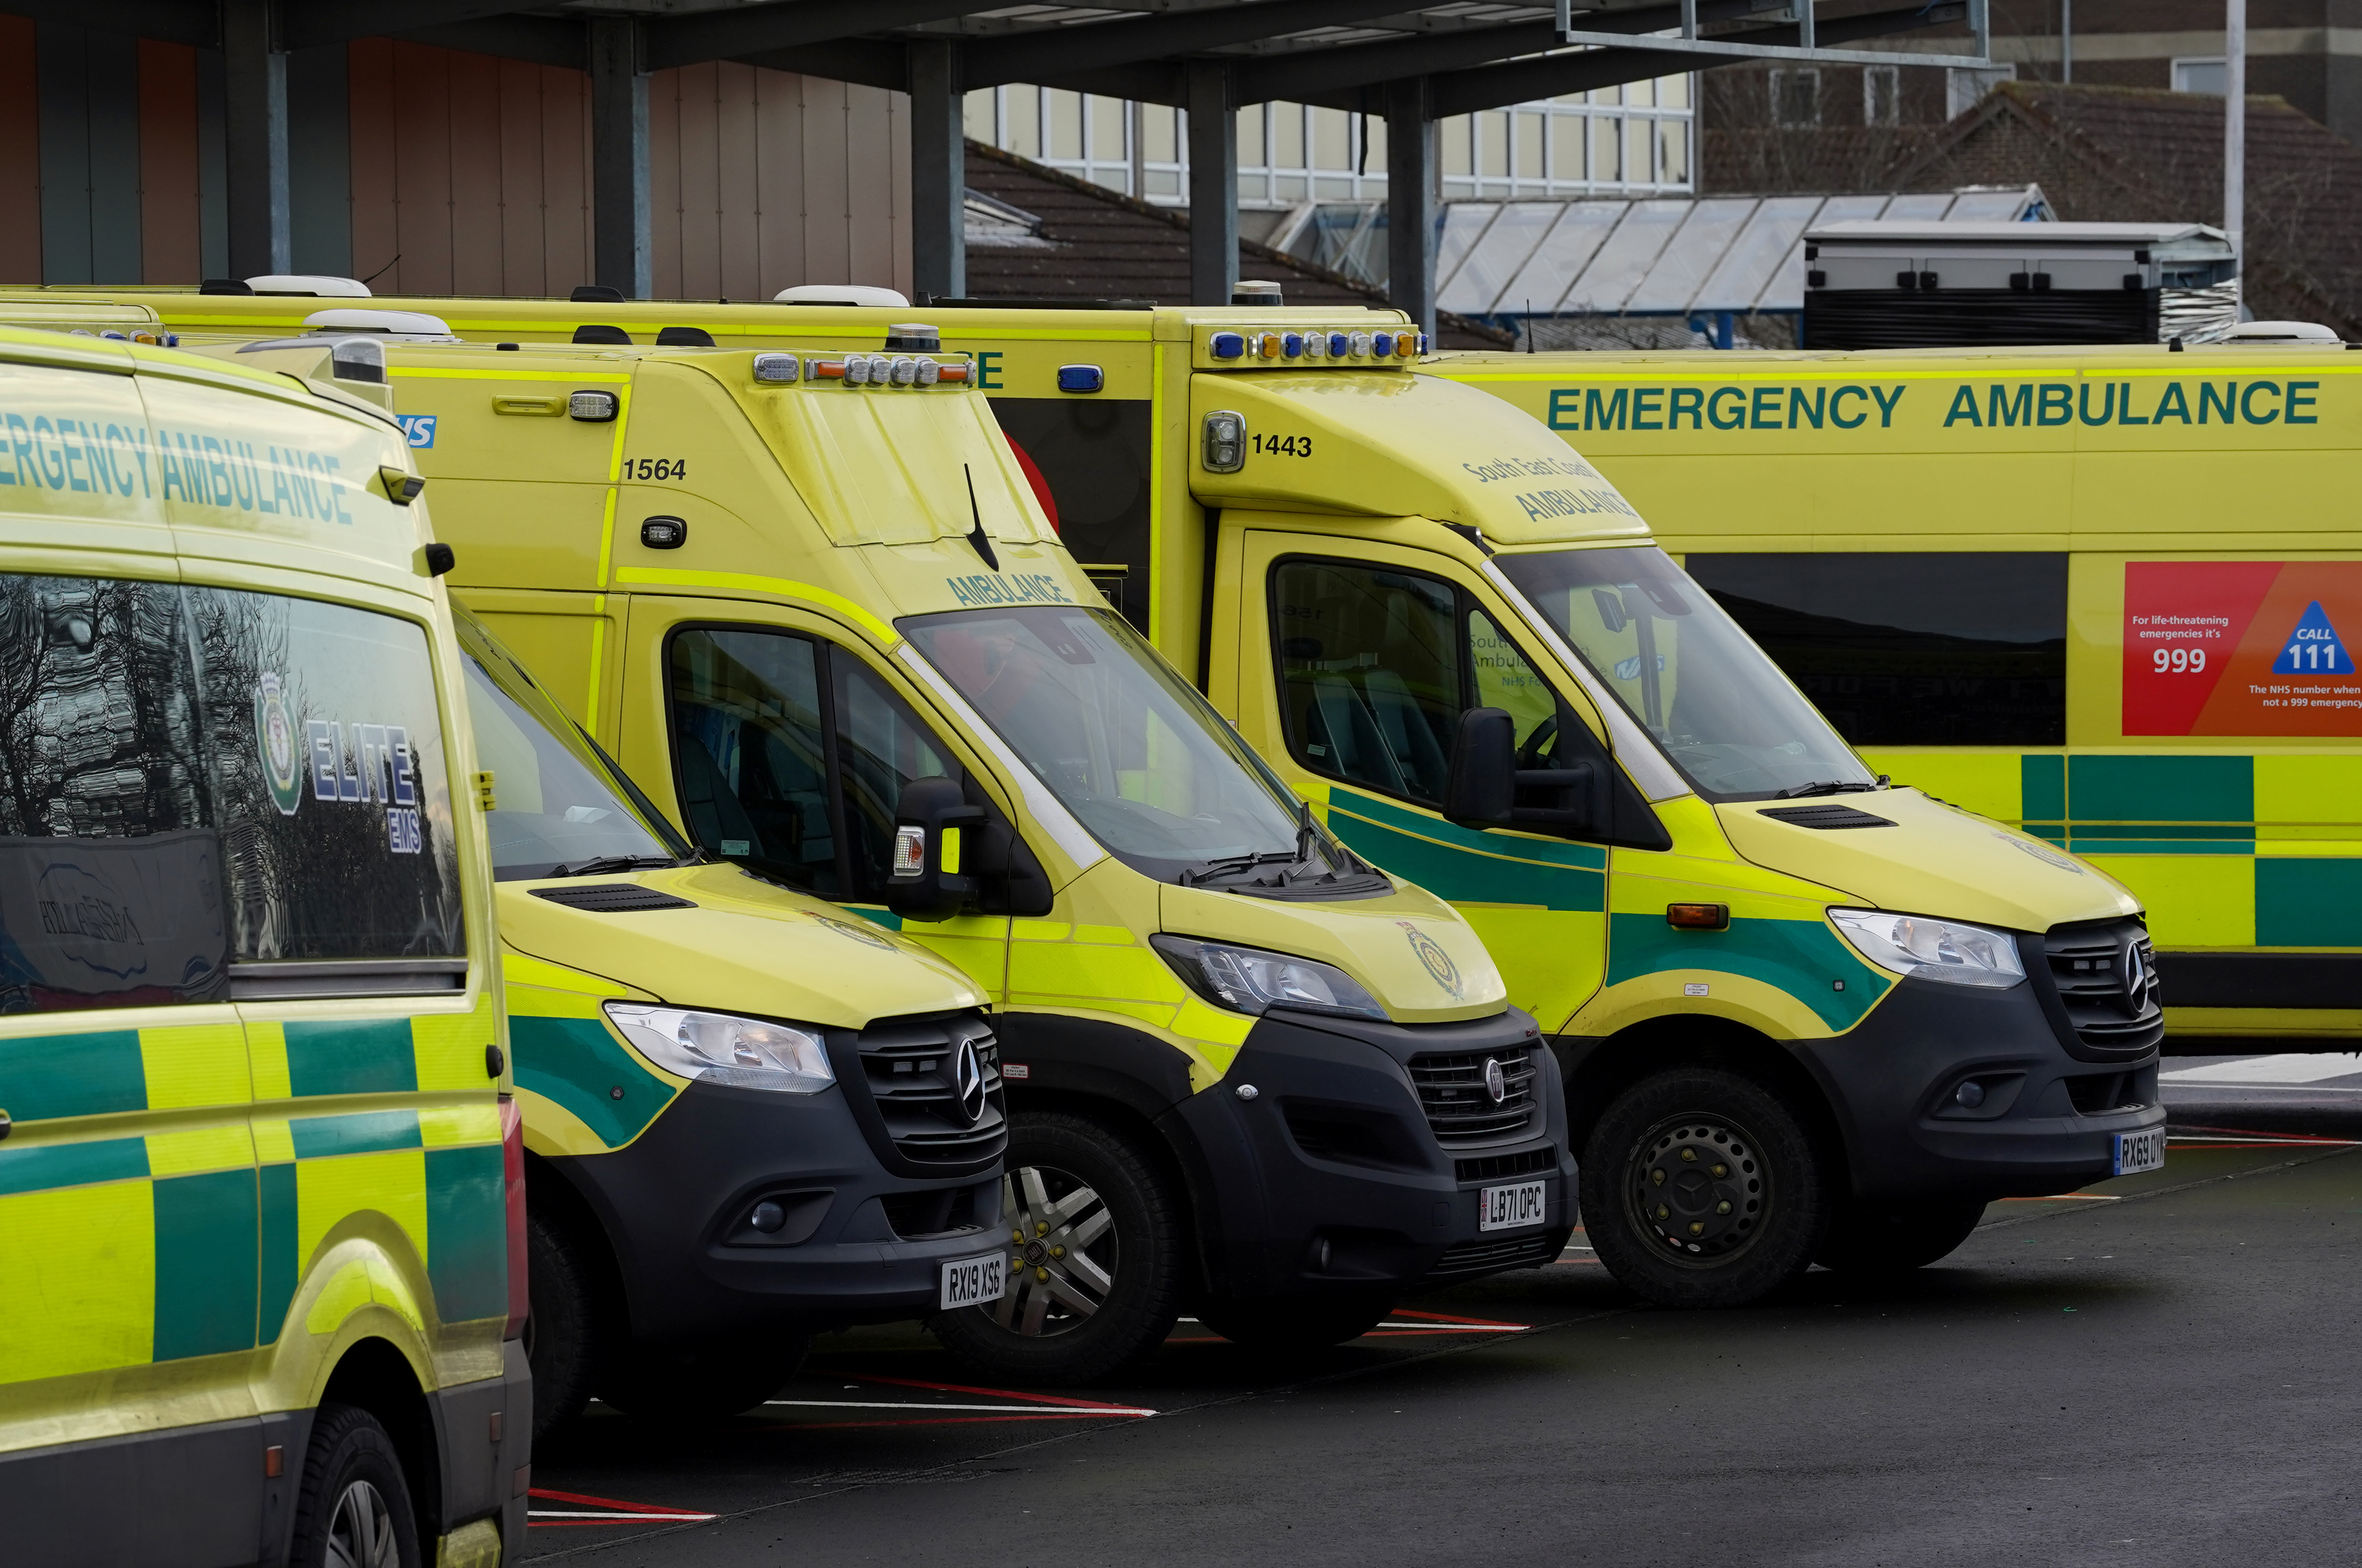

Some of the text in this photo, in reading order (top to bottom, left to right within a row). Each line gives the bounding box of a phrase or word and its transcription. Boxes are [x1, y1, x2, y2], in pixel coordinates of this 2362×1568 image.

[1549, 381, 2319, 431] EMERGENCY AMBULANCE
[1252, 434, 1311, 458] 1443
[160, 430, 353, 525] AMBULANCE
[624, 459, 686, 480] 1564
[1463, 458, 1599, 482] South East Coast
[1515, 490, 1639, 522] AMBULANCE
[946, 574, 1073, 606] AMBULANCE
[2133, 615, 2229, 627] For life-threatening
[2140, 629, 2203, 640] emergencies
[2297, 629, 2332, 639] CALL
[2153, 649, 2205, 672] 999
[2289, 645, 2335, 669] 111
[2249, 685, 2267, 693] The
[2293, 685, 2331, 693] number
[2334, 685, 2360, 693] when
[2311, 700, 2362, 709] emergency
[306, 720, 415, 805] ELITE
[387, 808, 421, 854] EMS
[2122, 1136, 2149, 1168] RX69
[1491, 1186, 1541, 1223] LB71 OPC
[949, 1260, 1000, 1302] RX19 XSG
